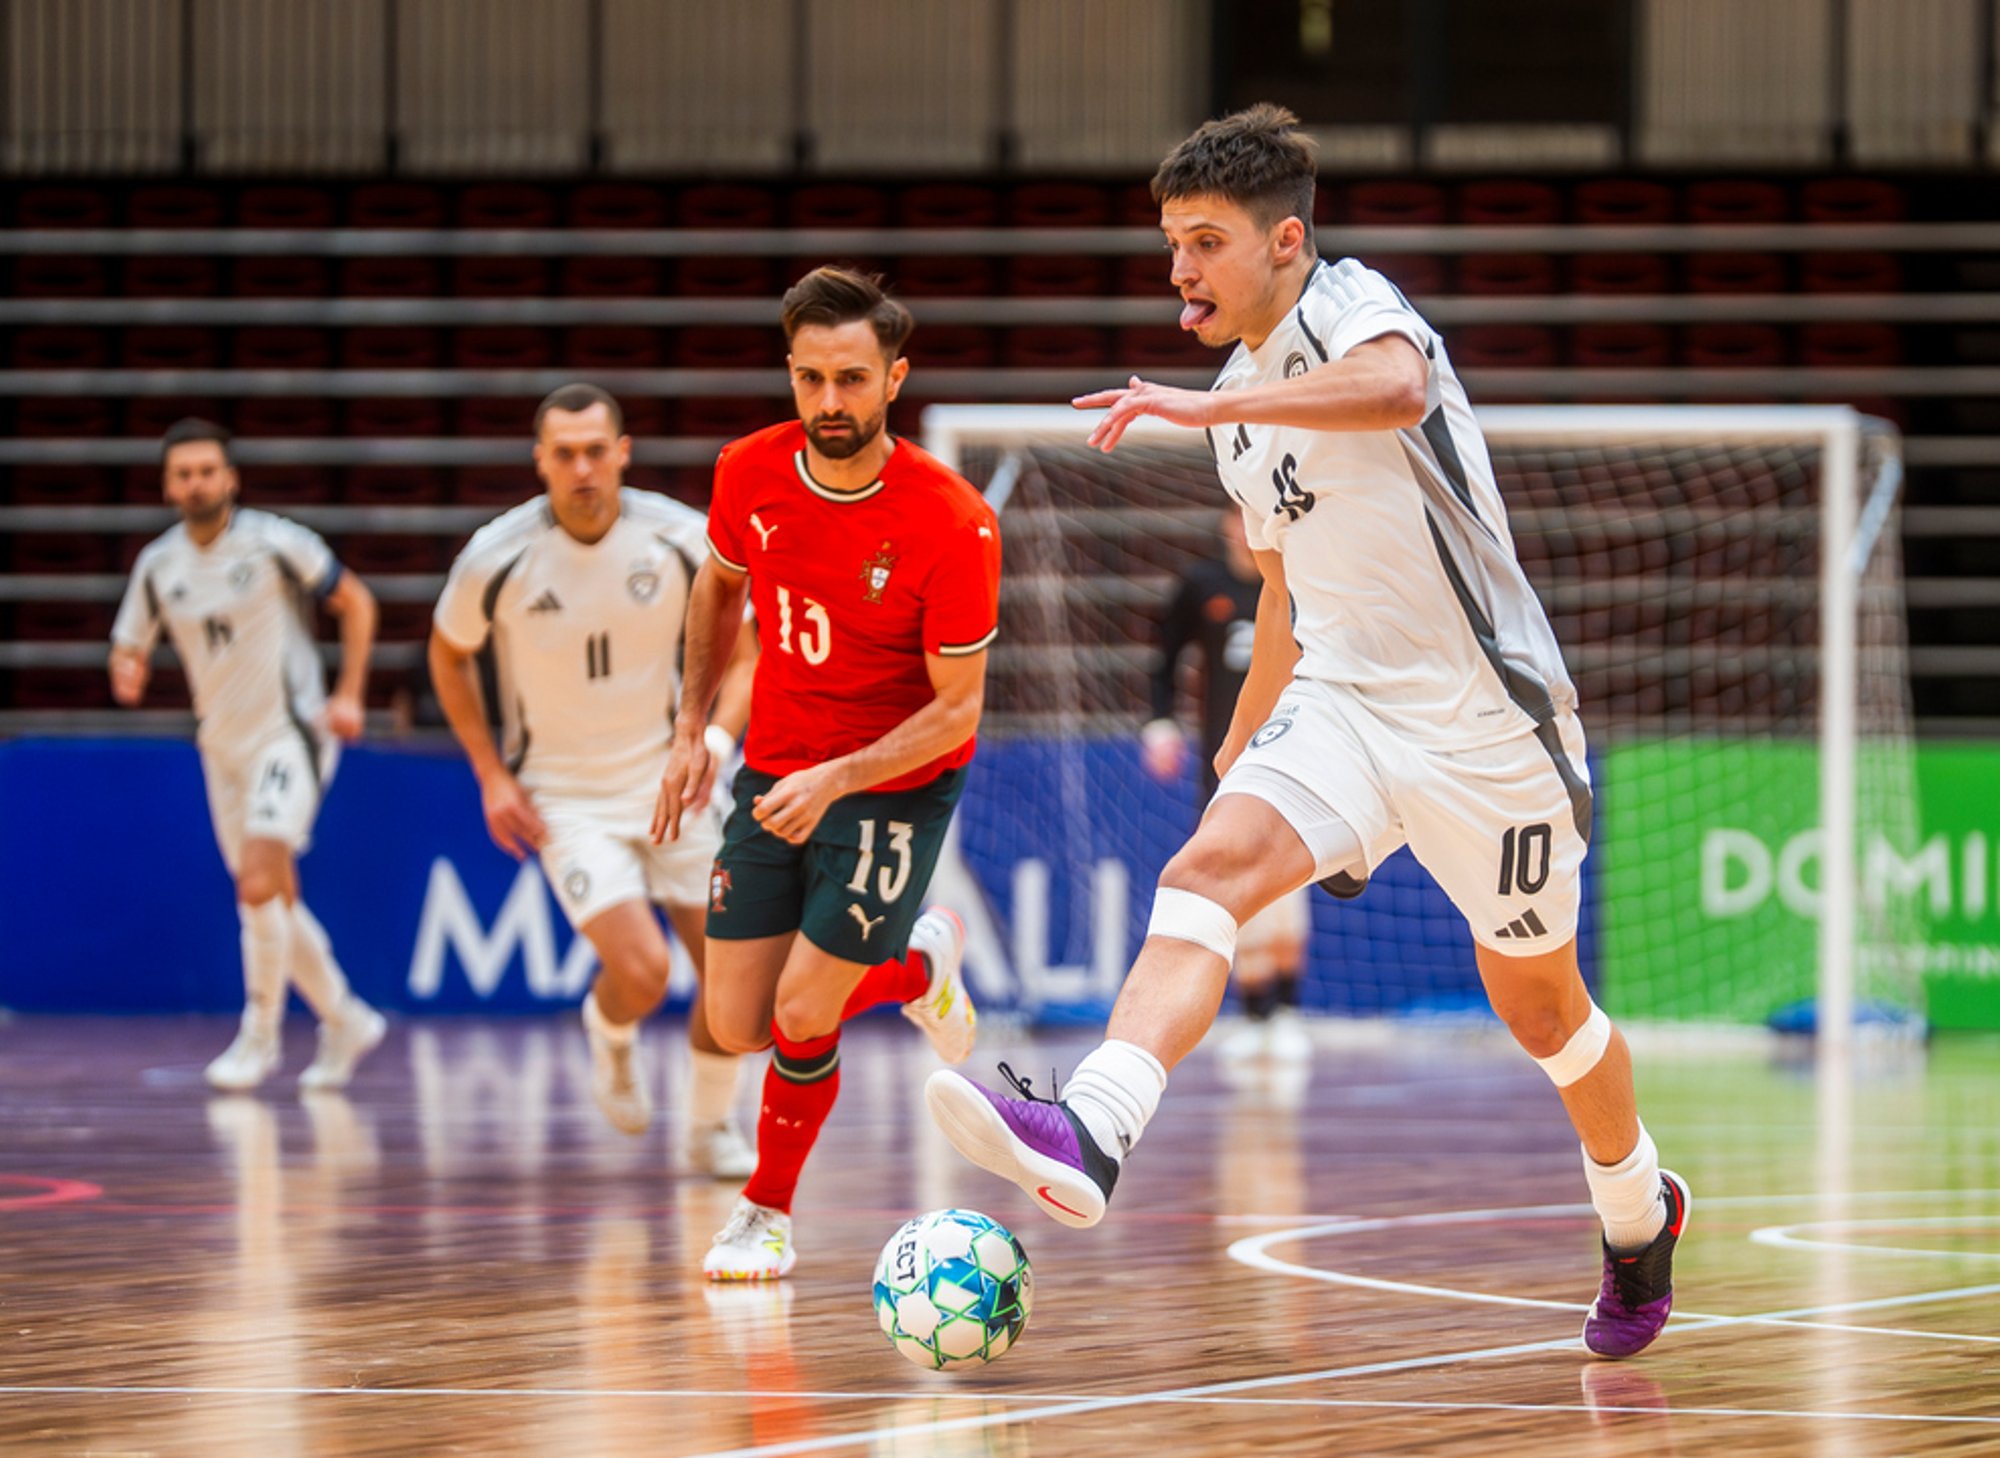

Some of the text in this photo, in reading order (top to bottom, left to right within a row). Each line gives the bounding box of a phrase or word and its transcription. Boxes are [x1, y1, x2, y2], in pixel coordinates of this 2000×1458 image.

[587, 630, 611, 681] 11
[776, 585, 831, 666] 13
[846, 819, 914, 904] 13
[1498, 822, 1551, 896] 10
[1700, 828, 2000, 920] DOMI
[896, 1217, 922, 1281] ELECT
